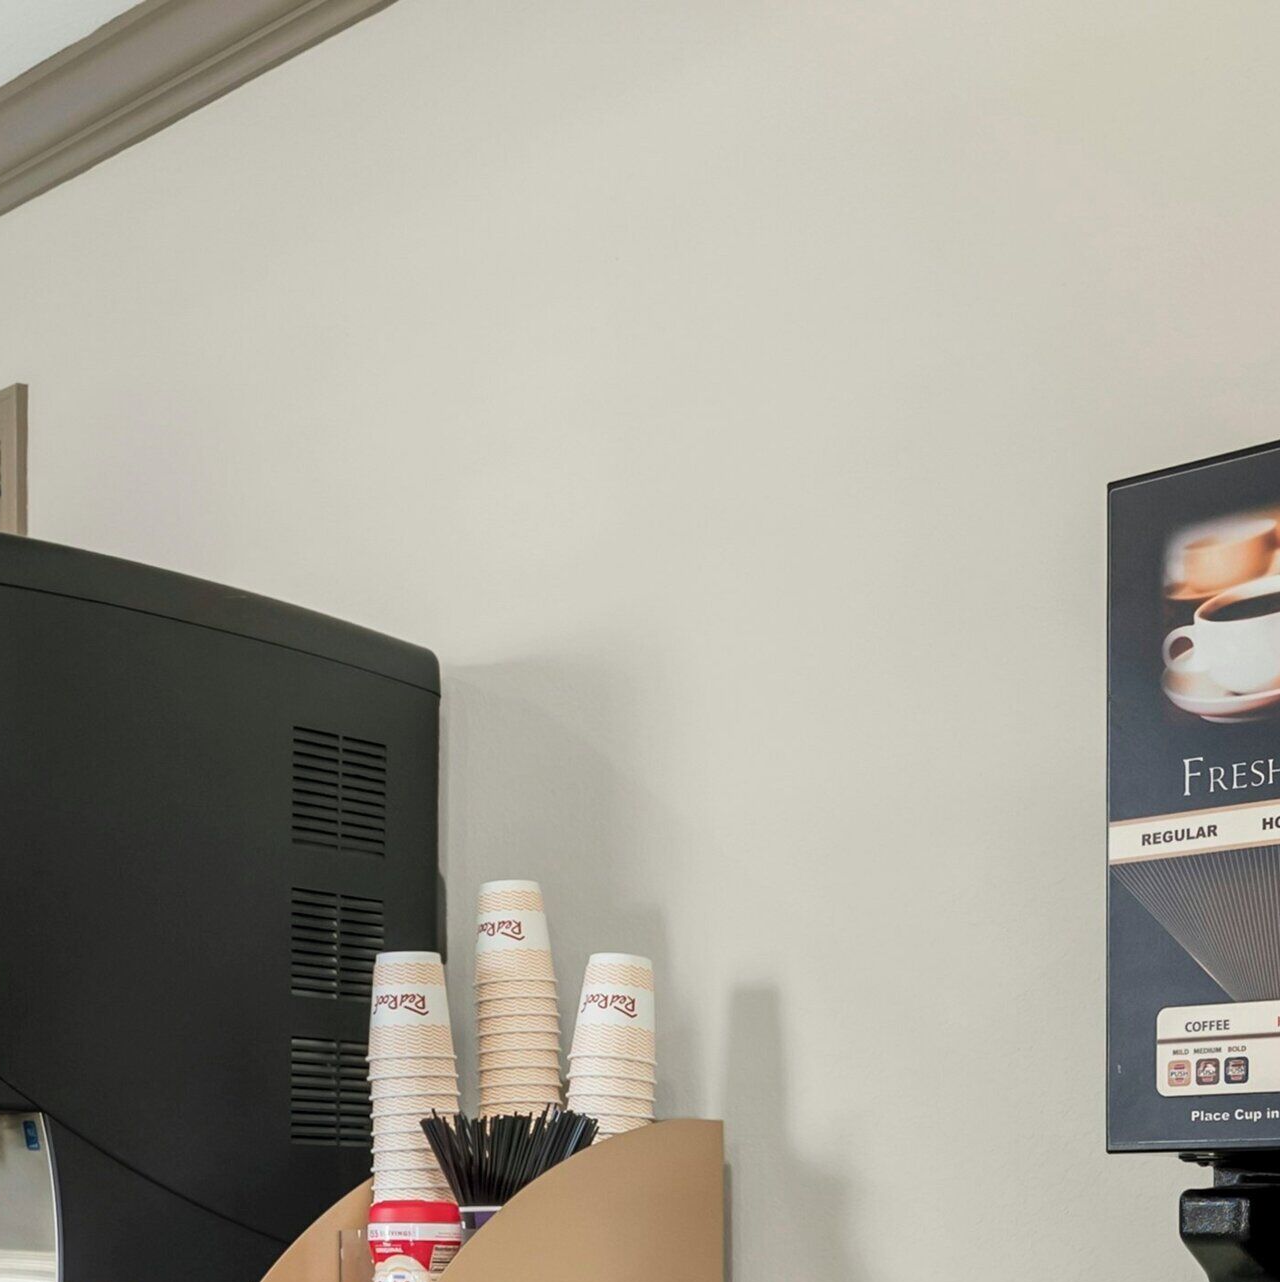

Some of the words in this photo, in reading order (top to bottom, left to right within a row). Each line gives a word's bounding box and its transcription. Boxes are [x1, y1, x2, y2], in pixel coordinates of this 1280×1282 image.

[1141, 824, 1218, 846] REGULAR
[400, 993, 426, 1012] Red
[610, 995, 636, 1013] Red
[1184, 1019, 1231, 1033] COFFEE
[1227, 1045, 1247, 1053] BOLD
[1191, 1109, 1230, 1122] Place
[1234, 1107, 1262, 1123] Cup
[1266, 1107, 1280, 1119] in
